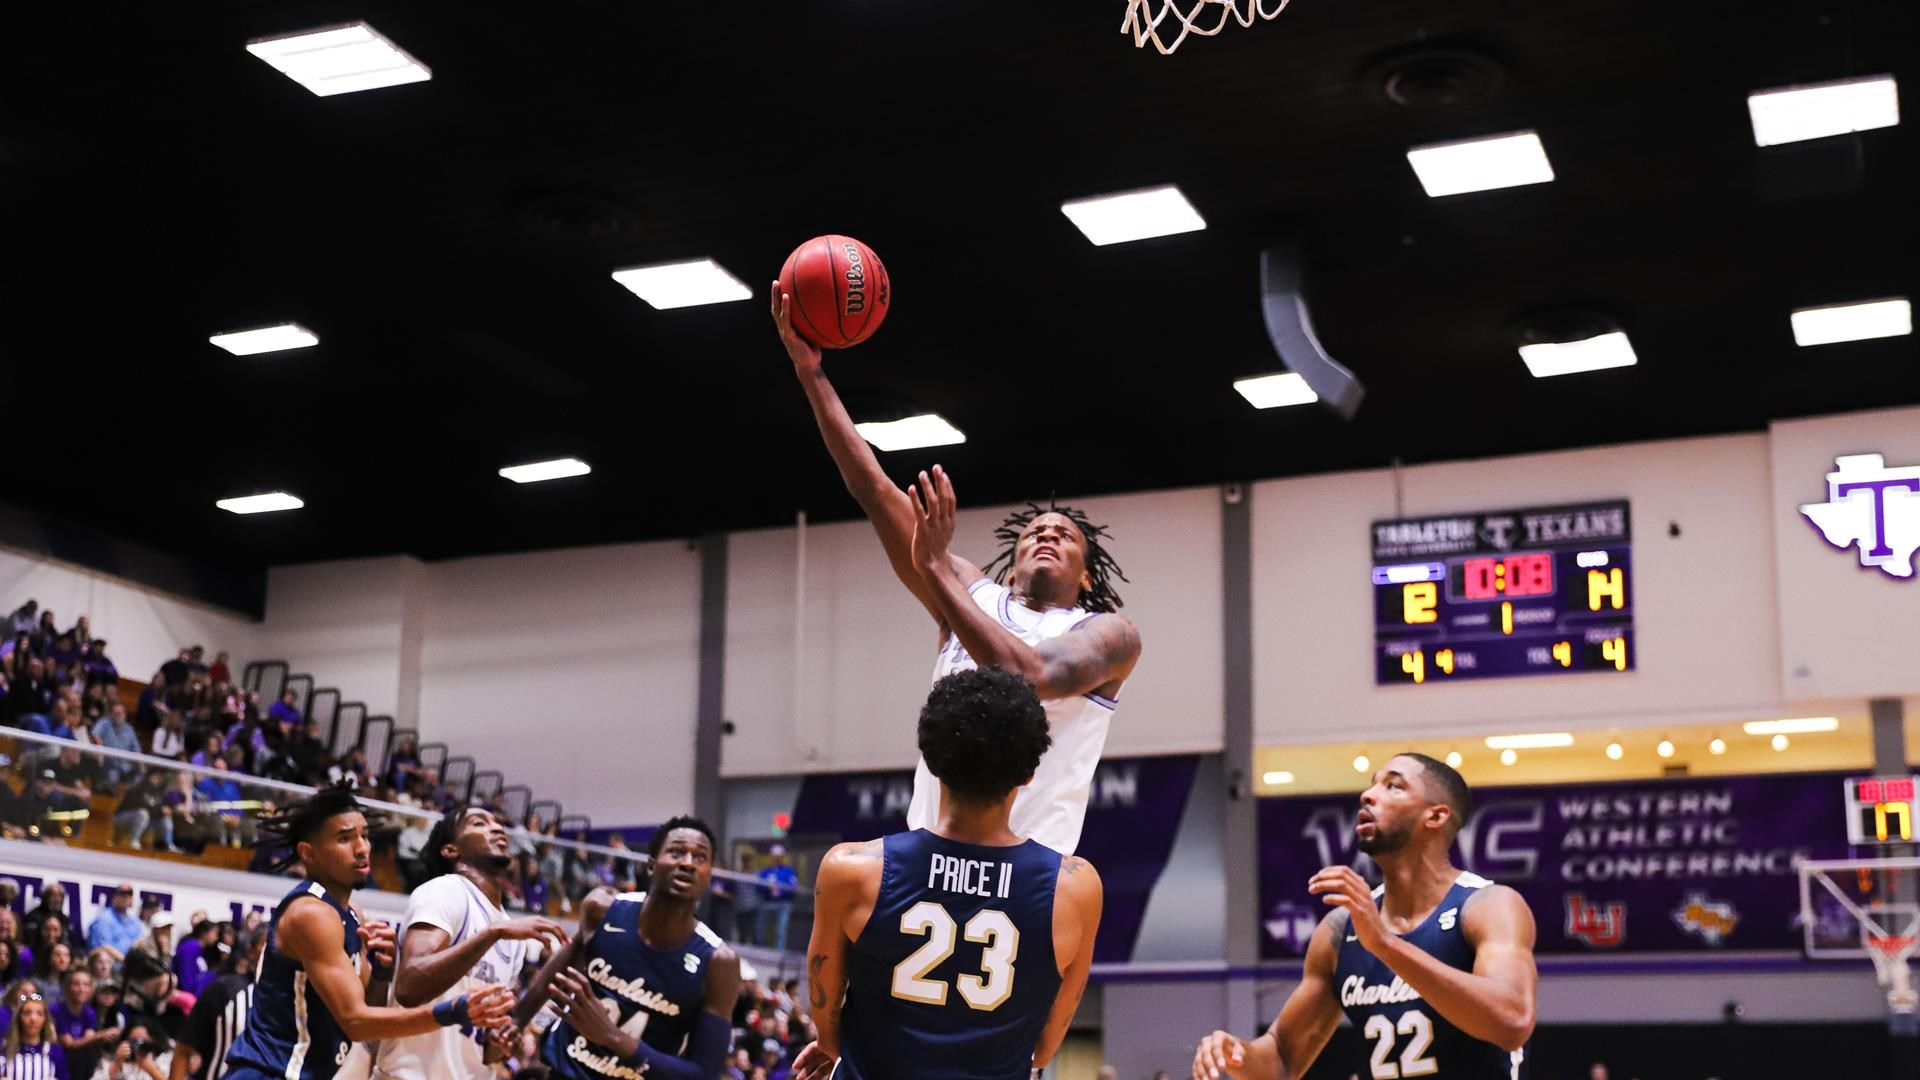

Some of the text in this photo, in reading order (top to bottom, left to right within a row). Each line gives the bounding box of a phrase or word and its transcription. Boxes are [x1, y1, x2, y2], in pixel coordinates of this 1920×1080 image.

[844, 242, 866, 316] Wilson
[1523, 509, 1625, 542] TEXANS
[1402, 649, 1424, 684] 4
[1602, 637, 1625, 671] 4
[1559, 792, 1732, 820] WESTERN
[1562, 820, 1738, 848] ATHLETIC
[928, 853, 1013, 899] PRICE II
[890, 900, 1020, 1013] 23
[588, 957, 681, 1016] Charleston
[1364, 1010, 1439, 1080] 22
